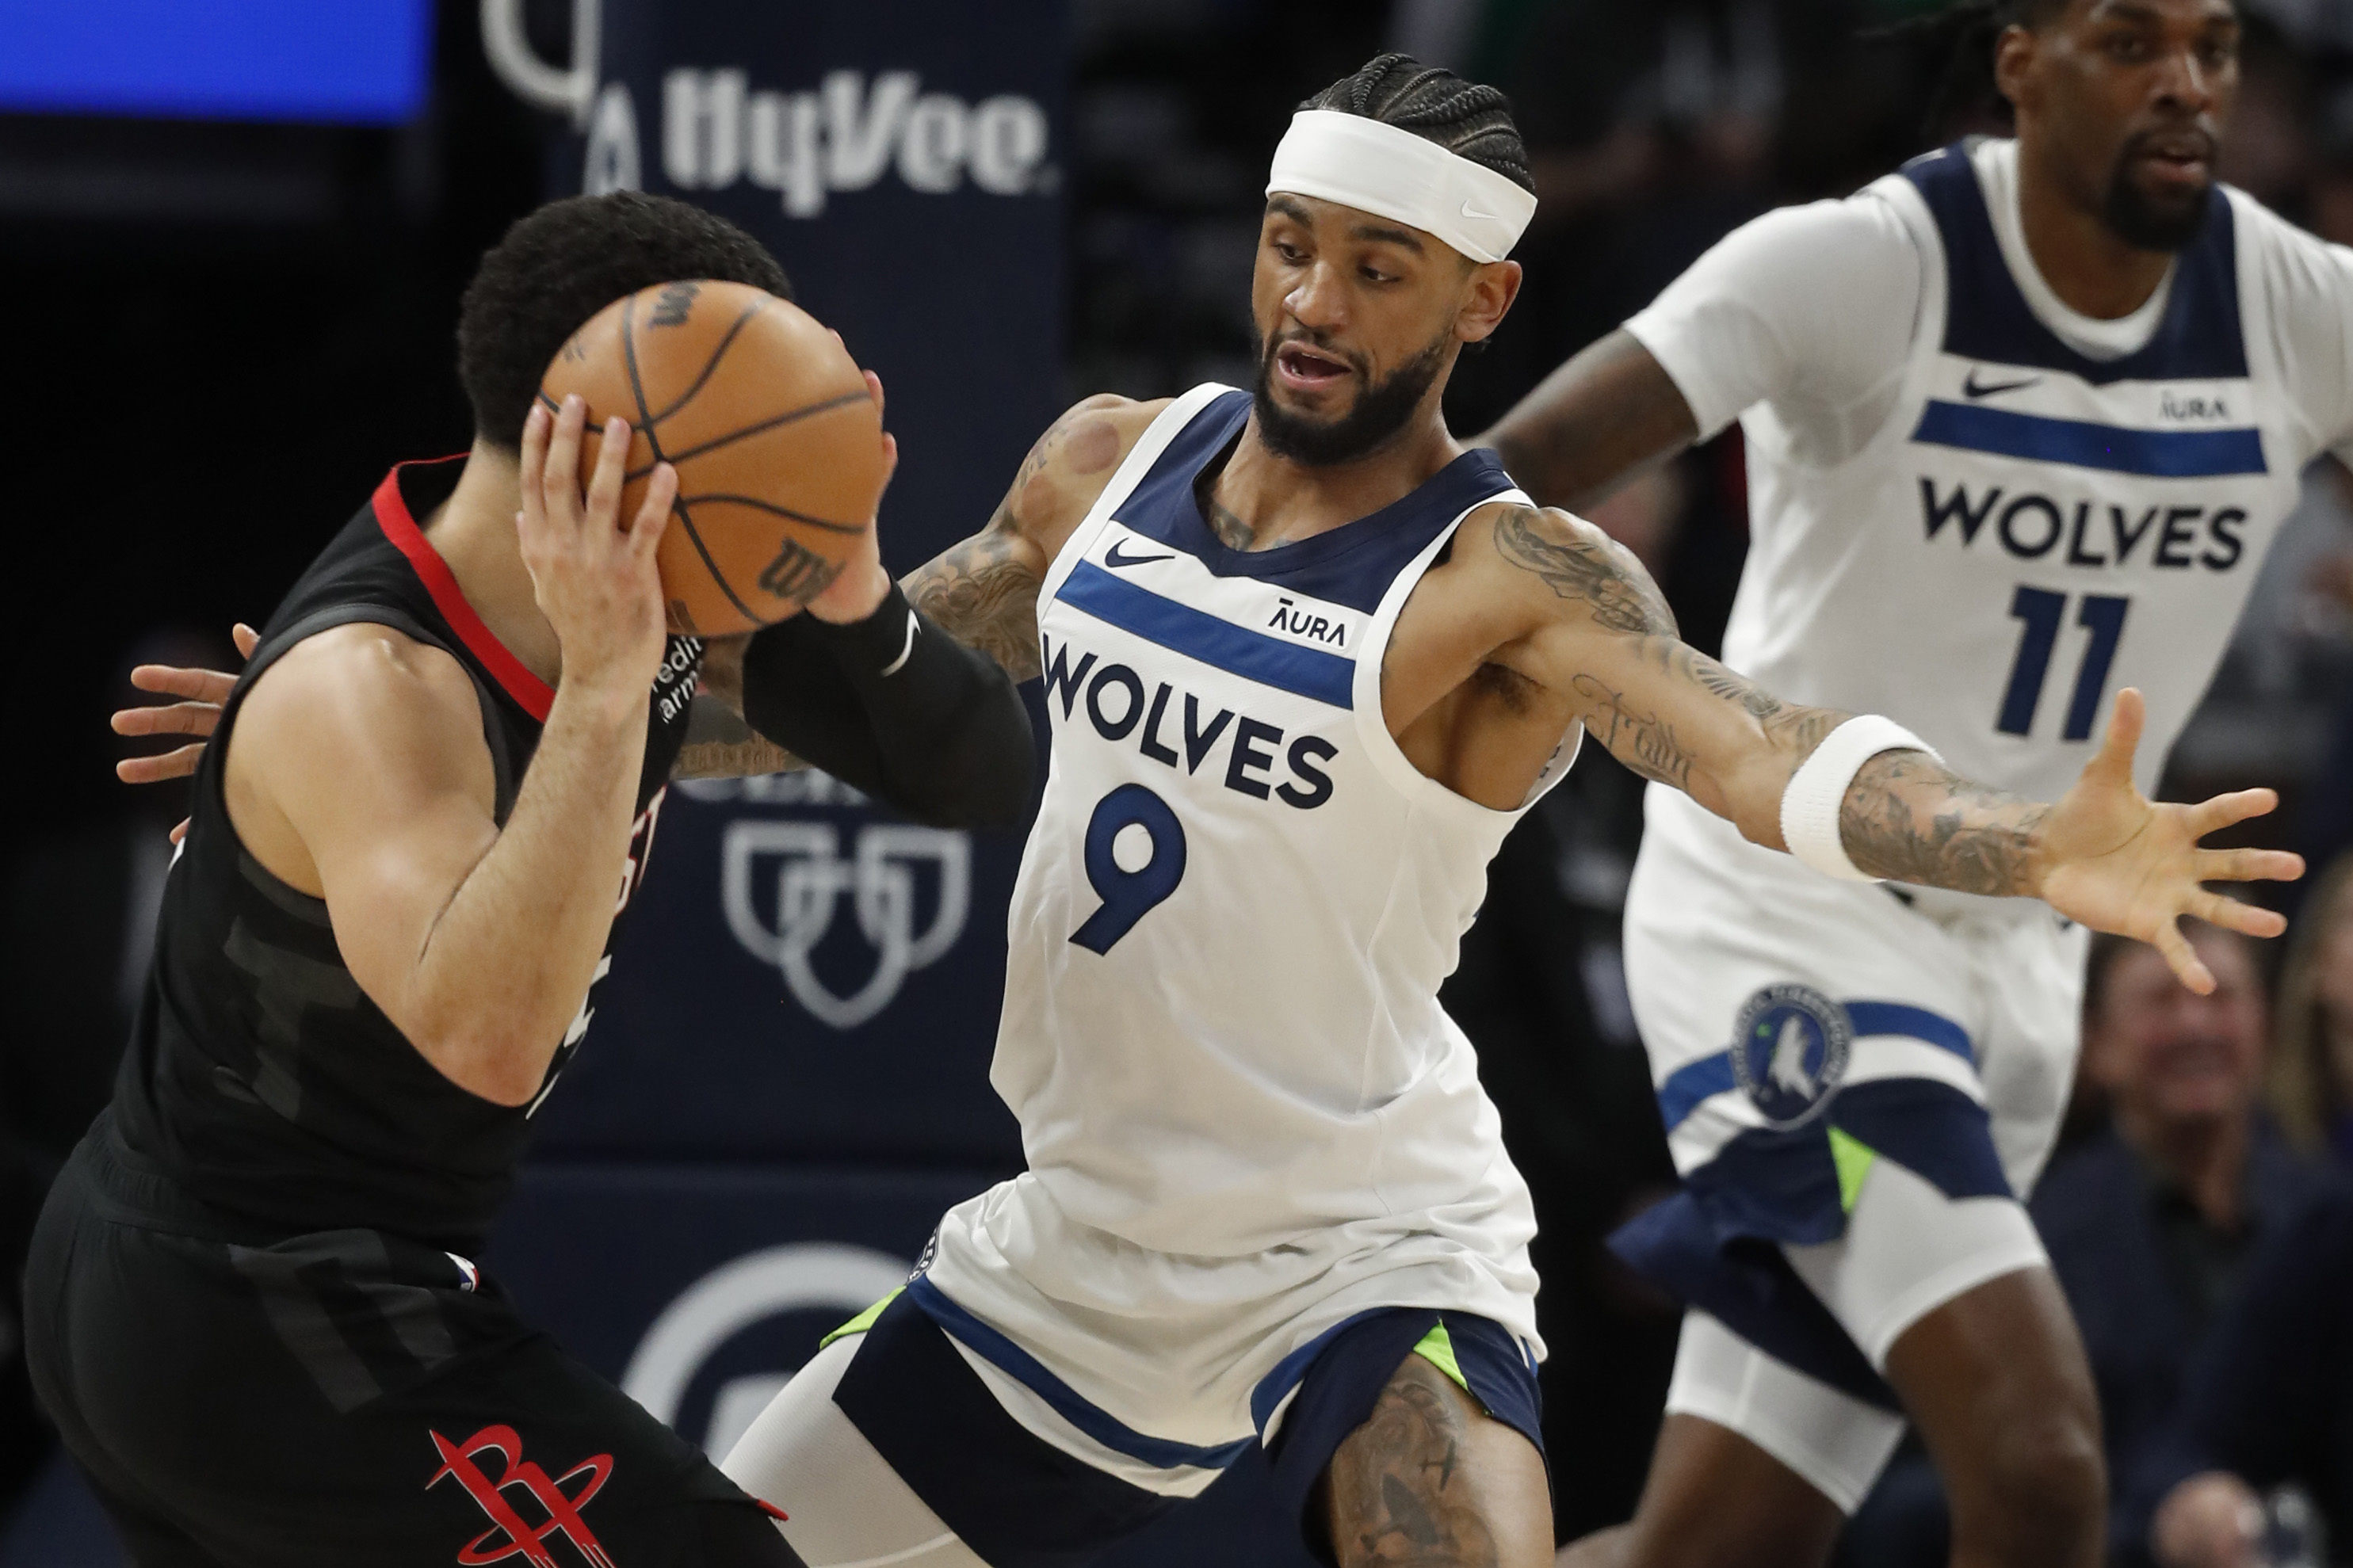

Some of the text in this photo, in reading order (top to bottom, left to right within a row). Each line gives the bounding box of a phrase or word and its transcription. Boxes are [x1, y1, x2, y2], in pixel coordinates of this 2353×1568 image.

[1919, 476, 2248, 571] WOLVES
[1043, 631, 1339, 810] WOLVES
[1996, 585, 2132, 741] 11
[1068, 782, 1187, 957] 9
